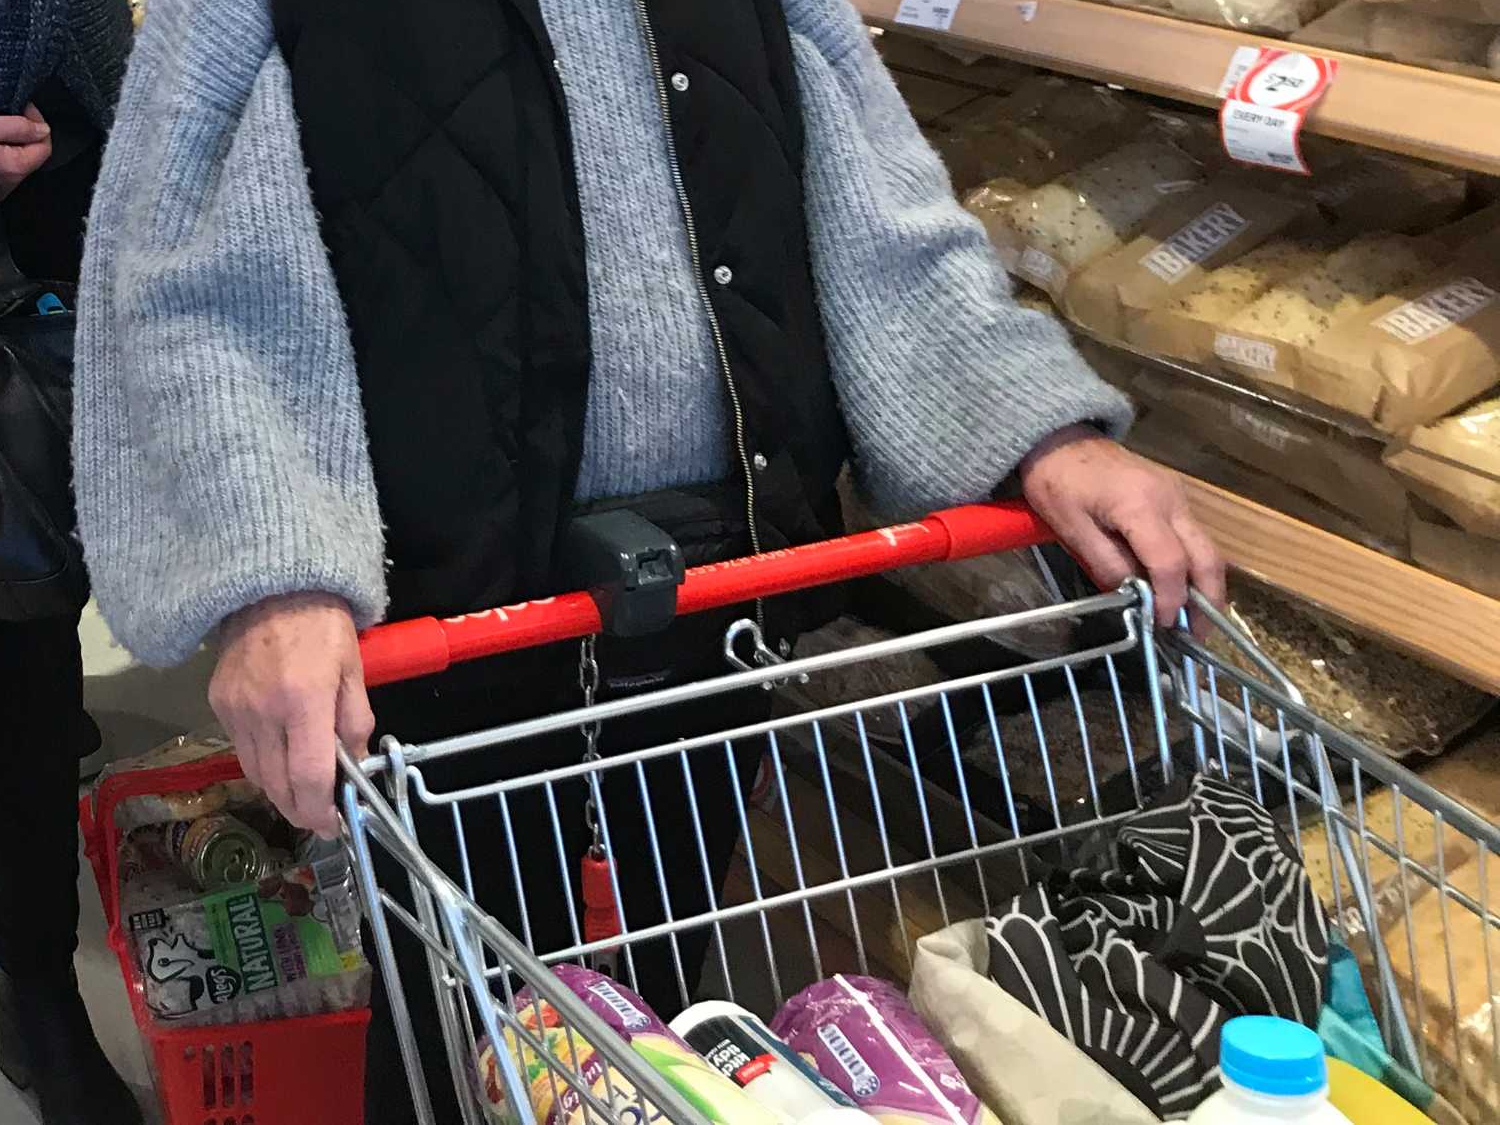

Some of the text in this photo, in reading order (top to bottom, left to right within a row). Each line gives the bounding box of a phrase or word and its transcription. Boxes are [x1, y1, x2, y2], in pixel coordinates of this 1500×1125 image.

[1151, 202, 1249, 282] BAKERY
[1388, 277, 1500, 343] BAKERY
[230, 894, 277, 993] NATURAL
